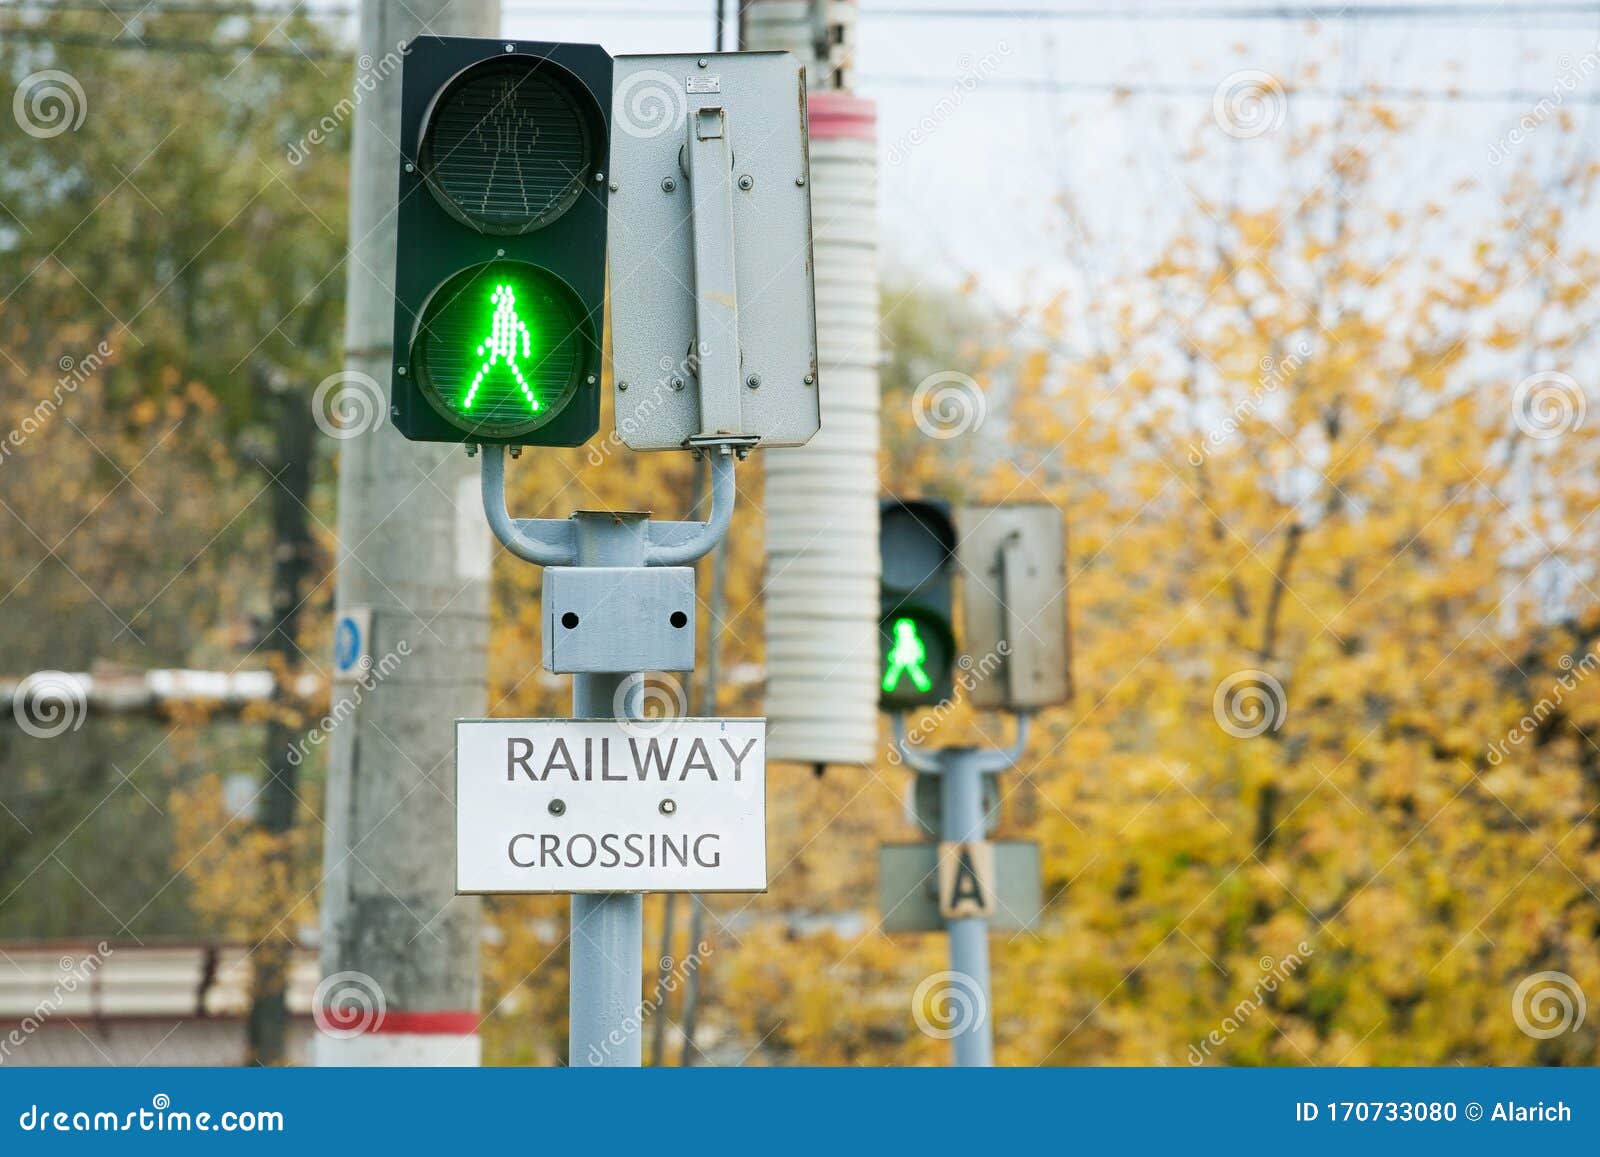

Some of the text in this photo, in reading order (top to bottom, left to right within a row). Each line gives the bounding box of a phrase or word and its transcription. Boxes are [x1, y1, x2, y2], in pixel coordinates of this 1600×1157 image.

[507, 737, 757, 782] RAILWAY
[508, 833, 720, 868] CROSSING
[950, 846, 984, 909] A
